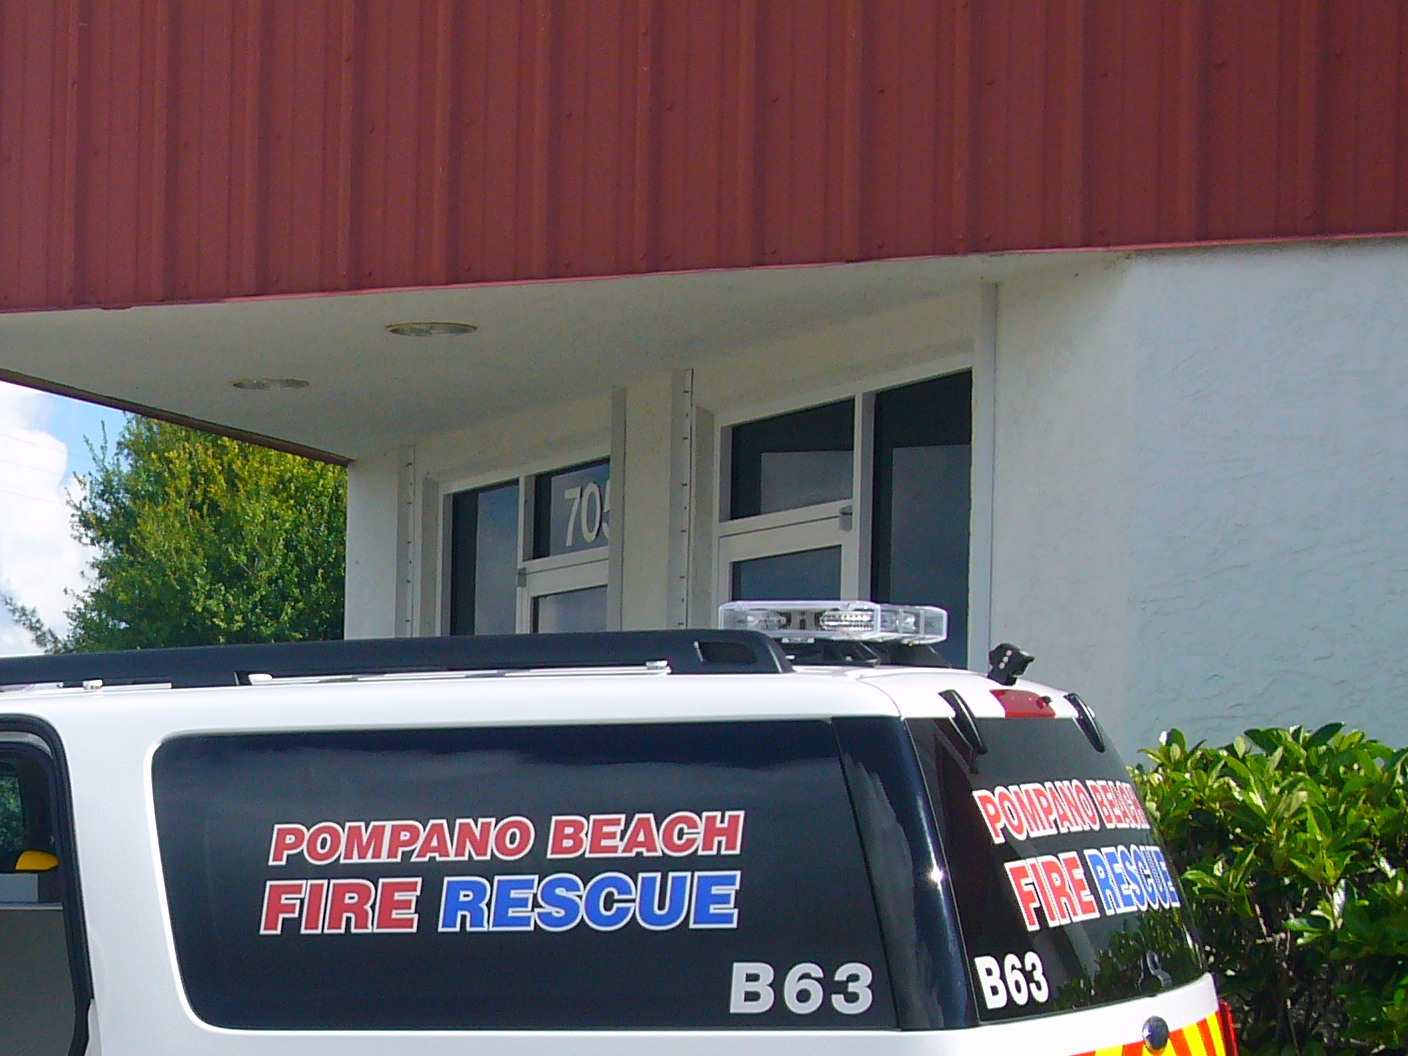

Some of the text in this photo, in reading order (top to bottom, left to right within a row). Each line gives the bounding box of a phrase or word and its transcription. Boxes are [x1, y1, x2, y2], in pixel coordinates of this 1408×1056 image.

[268, 810, 745, 865] POMPANO BEACH
[972, 779, 1100, 844] POMPANO
[259, 871, 741, 934] FIRE RESCUE
[1004, 845, 1181, 932] FIRE RESCUE
[729, 961, 873, 1014] B63
[973, 951, 1049, 1010] B63
